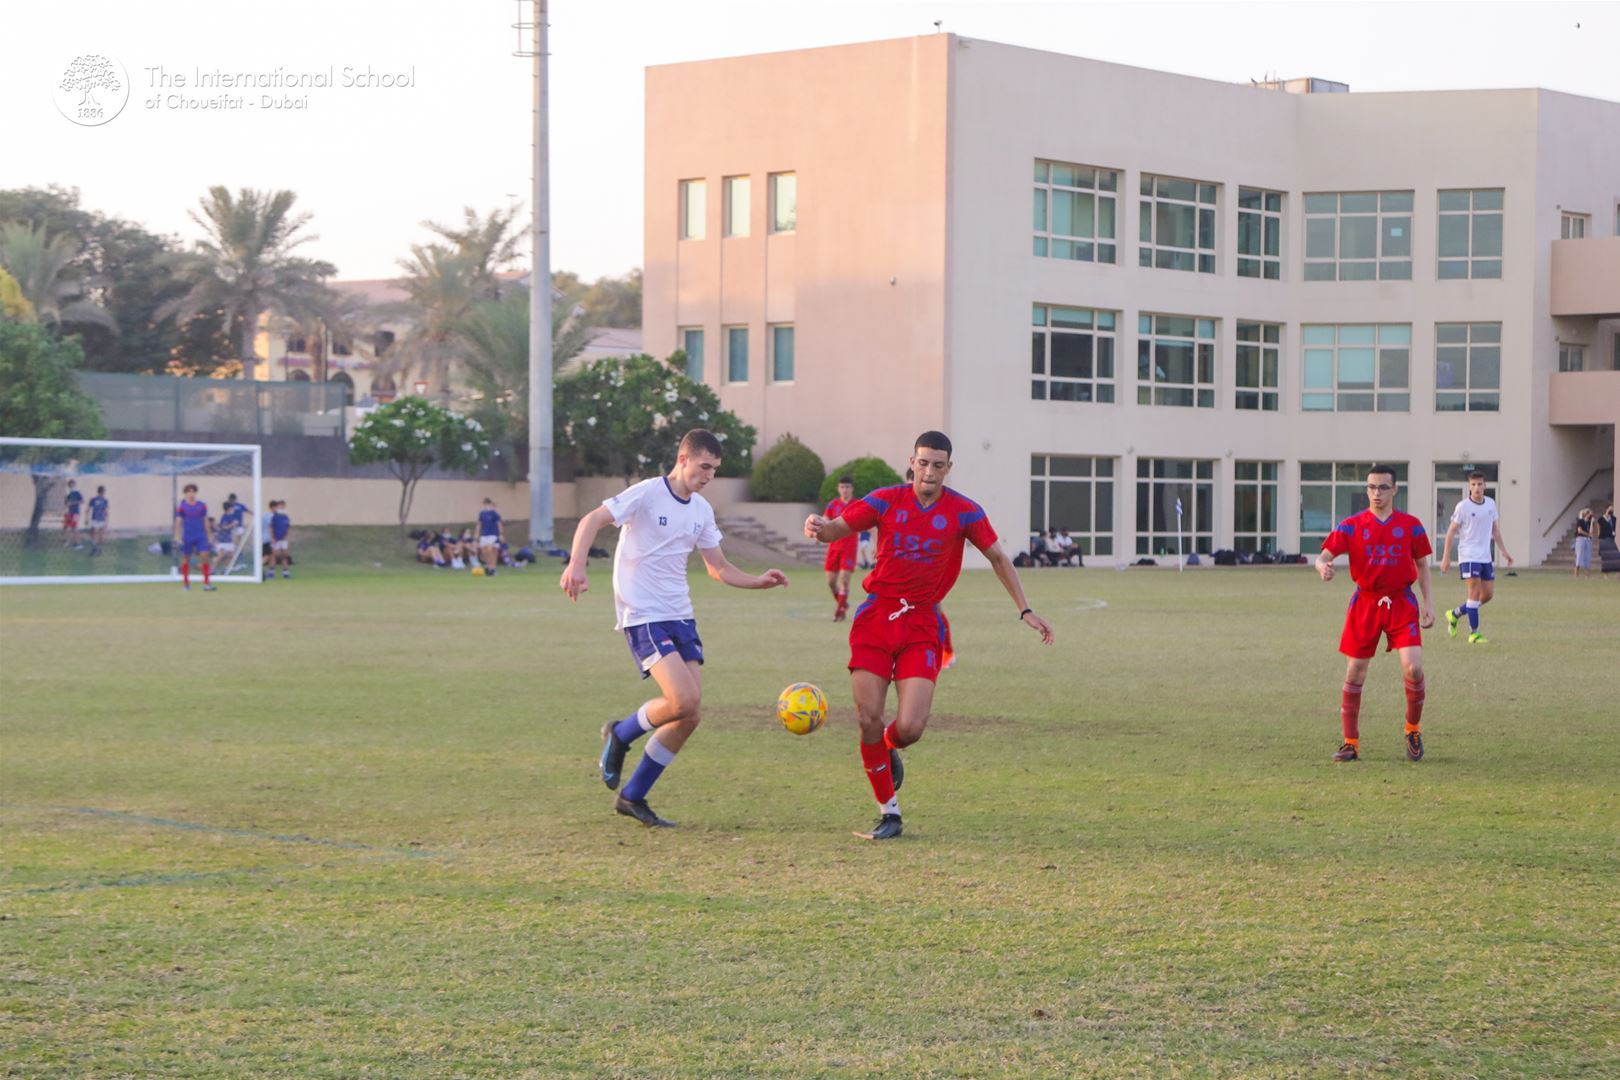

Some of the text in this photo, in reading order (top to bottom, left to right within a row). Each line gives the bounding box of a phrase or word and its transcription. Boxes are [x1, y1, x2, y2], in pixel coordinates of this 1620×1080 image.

[658, 516, 668, 527] 13
[1362, 528, 1371, 540] 5
[893, 532, 944, 553] ISC
[1366, 544, 1403, 557] ISC
